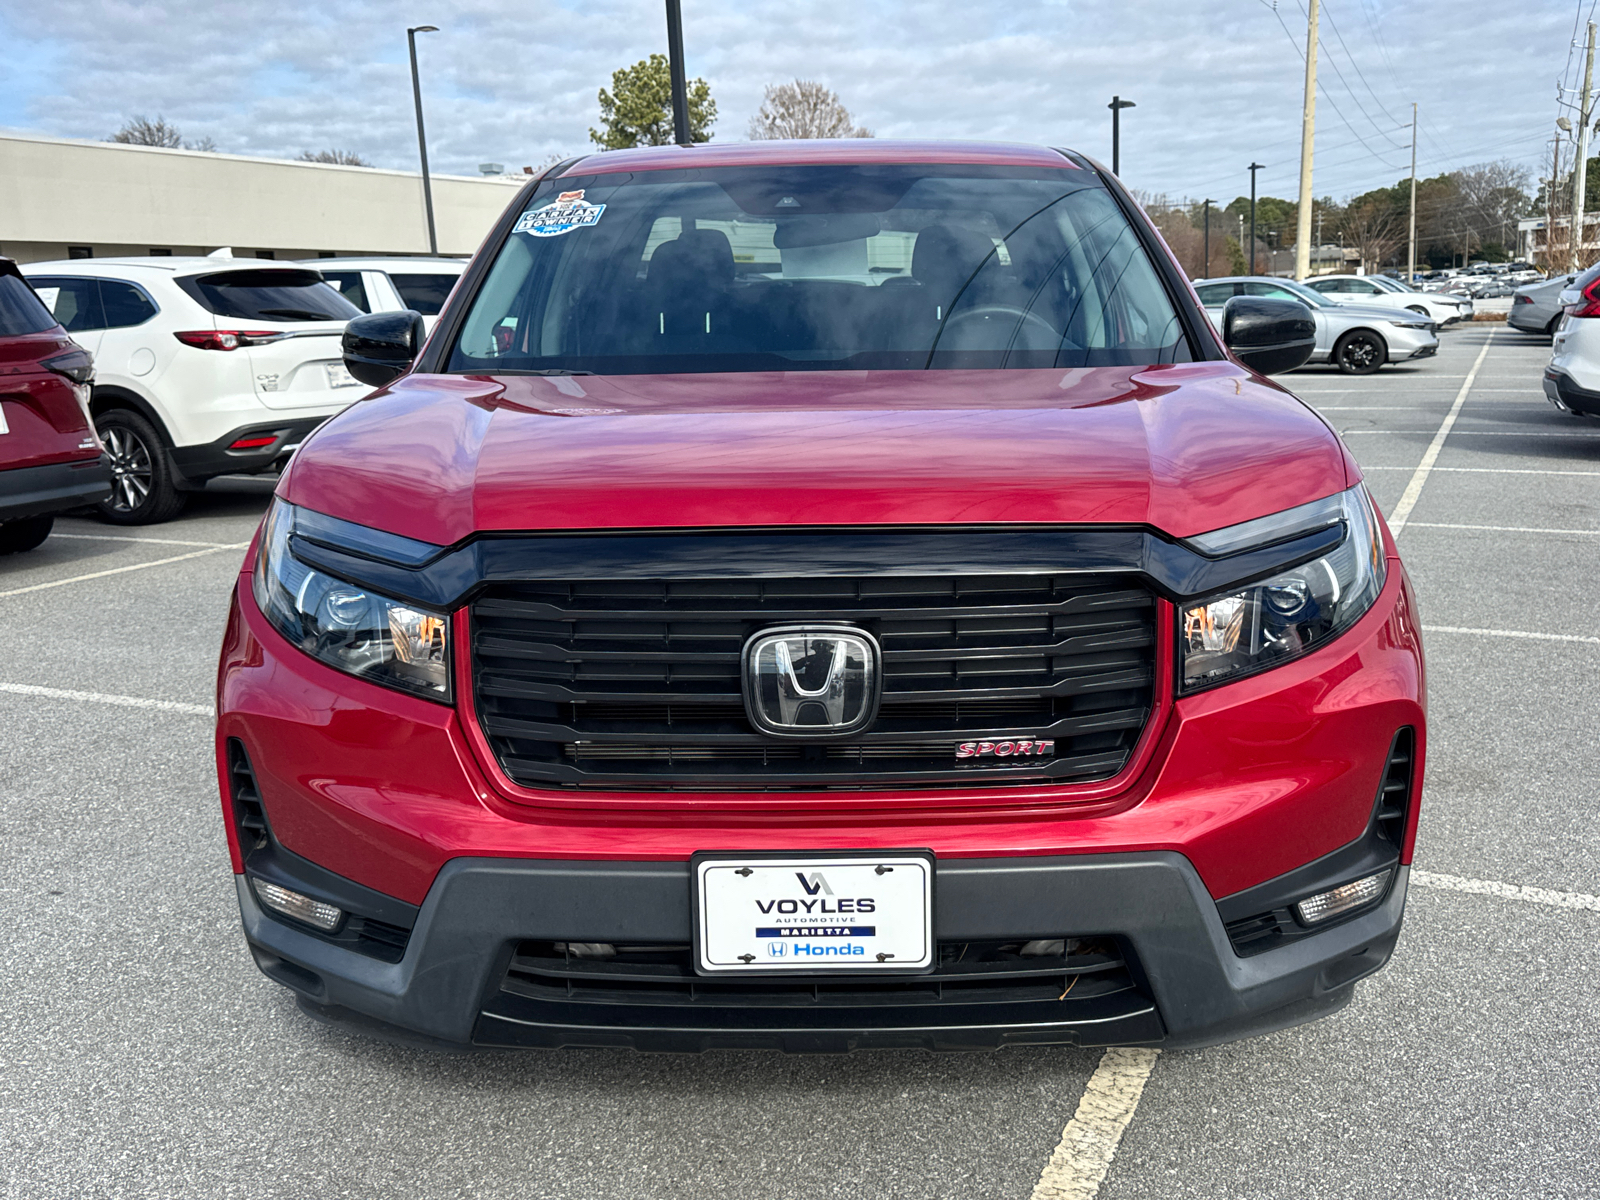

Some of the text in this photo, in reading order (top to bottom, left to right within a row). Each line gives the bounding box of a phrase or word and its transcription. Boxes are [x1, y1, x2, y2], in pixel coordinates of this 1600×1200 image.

[526, 209, 598, 221] CARFAX
[533, 216, 594, 227] OWNER
[956, 740, 1054, 758] SPORT
[755, 898, 876, 914] VOYLES
[780, 927, 851, 936] MARIETTA
[793, 942, 865, 956] Honda
